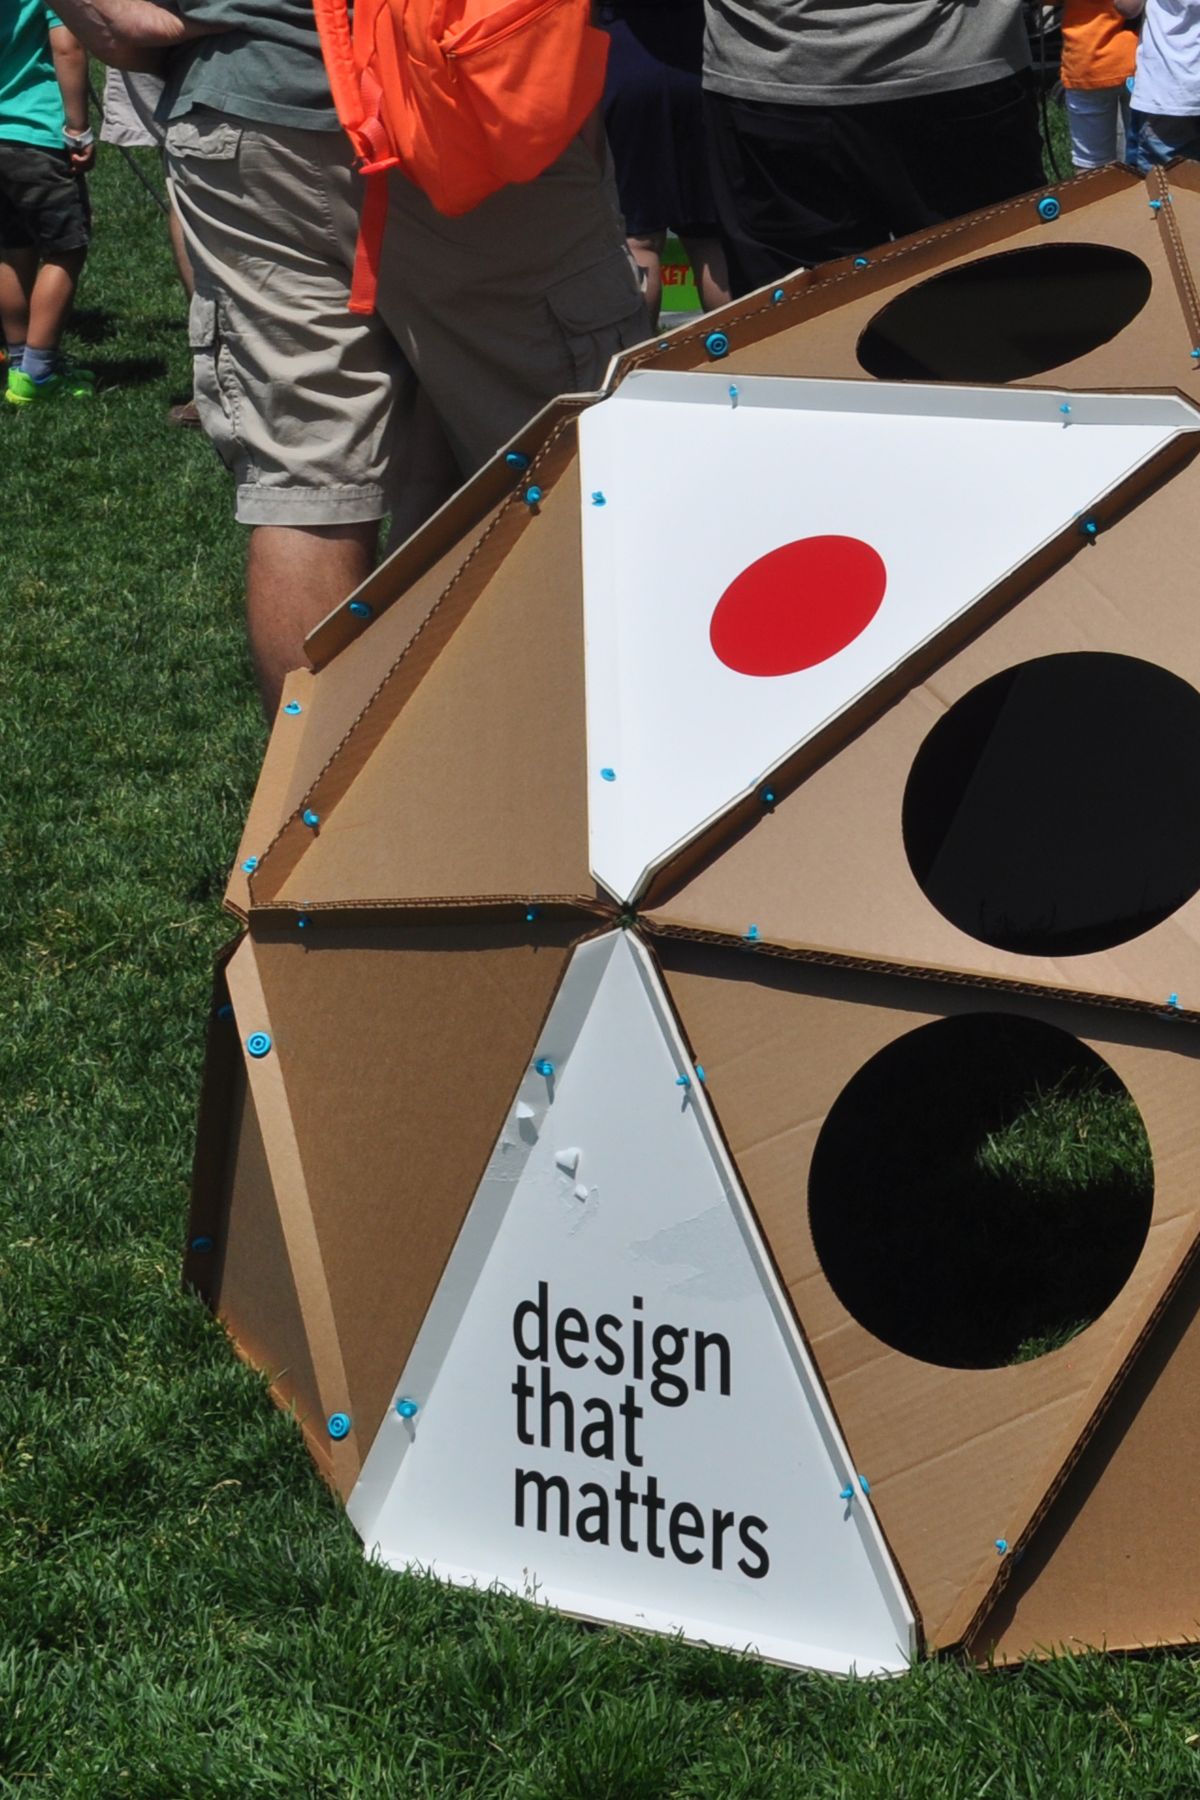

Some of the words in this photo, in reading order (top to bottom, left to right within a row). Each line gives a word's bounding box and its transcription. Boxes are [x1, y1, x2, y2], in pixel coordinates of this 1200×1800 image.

[513, 1280, 731, 1408] design
[511, 1364, 643, 1467] that
[514, 1467, 770, 1579] matters
